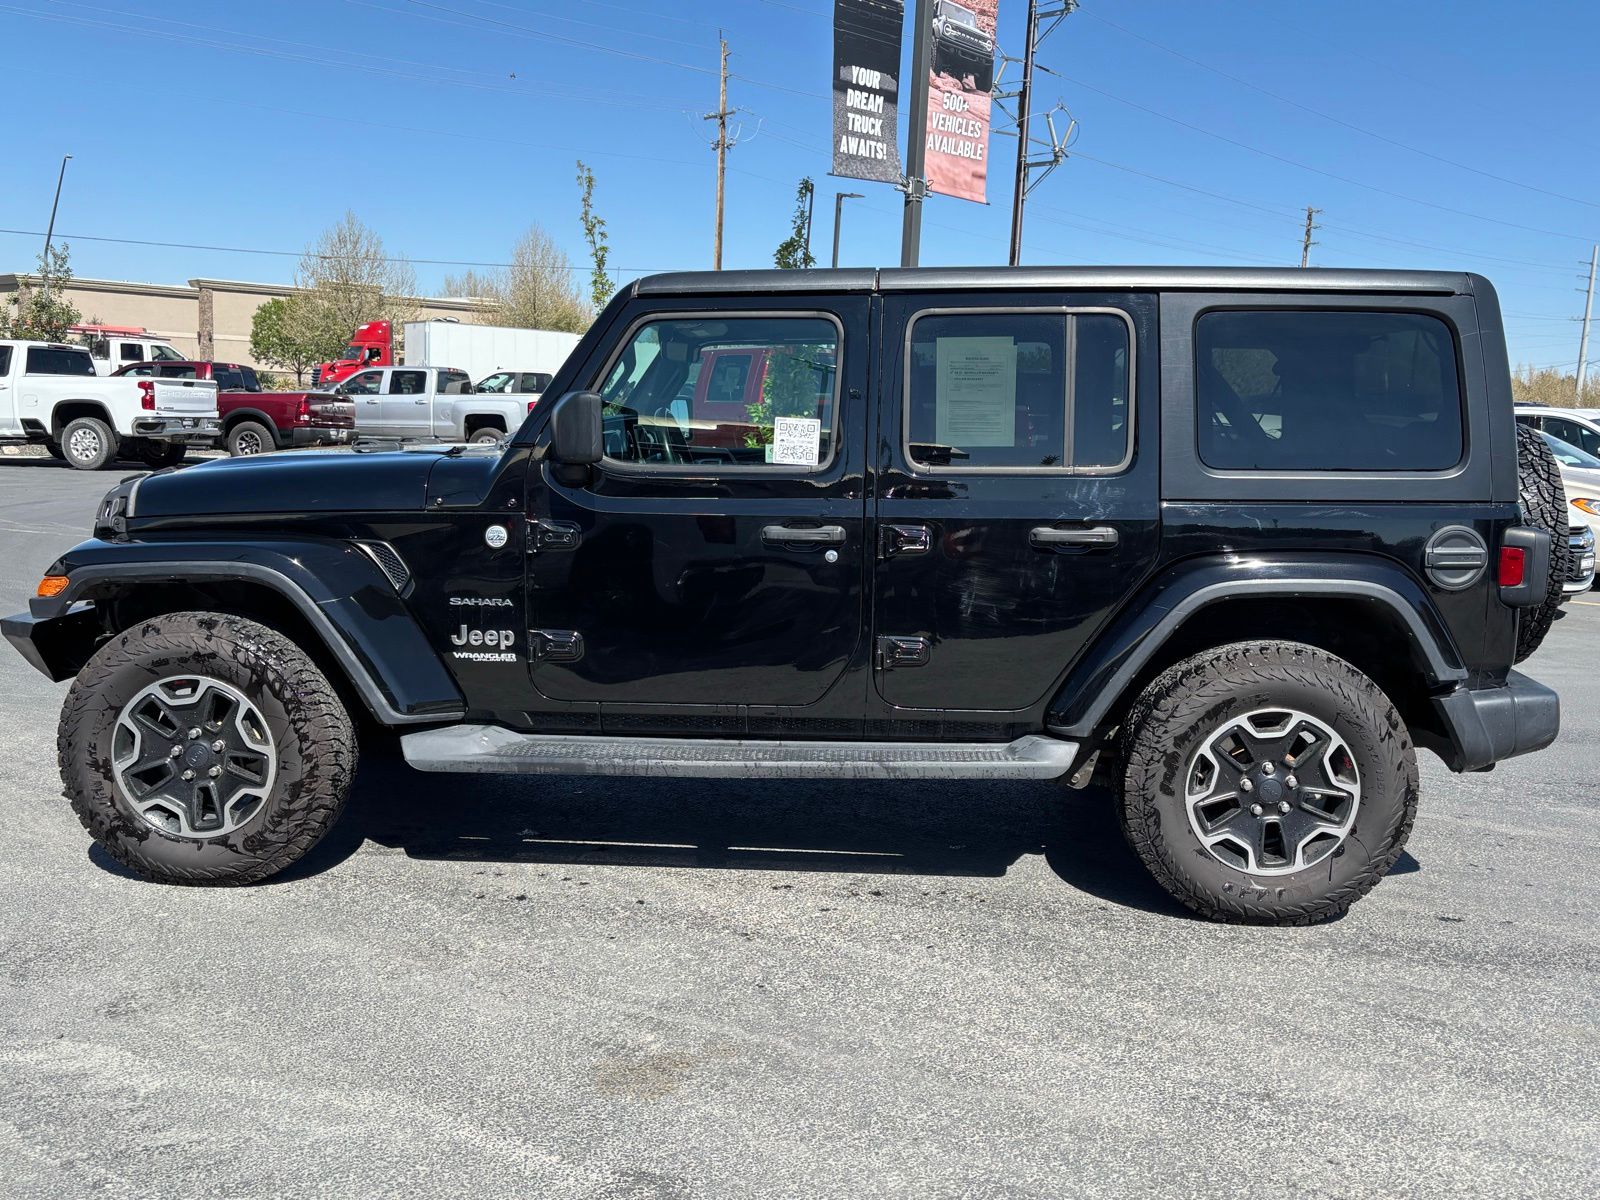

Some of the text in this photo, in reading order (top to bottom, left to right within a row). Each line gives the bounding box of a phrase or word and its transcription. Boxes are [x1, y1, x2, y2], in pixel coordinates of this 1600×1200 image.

[851, 65, 881, 90] YOUR
[846, 89, 884, 114] DREAM
[942, 93, 970, 112] 500+
[847, 113, 883, 137] TRUCK
[932, 112, 982, 138] VEHICLES
[840, 135, 887, 160] AWAITS!
[926, 133, 985, 161] AVAILABLE
[449, 597, 514, 607] SAHARA
[451, 624, 515, 650] Jeep
[452, 651, 516, 660] WRANGLER
